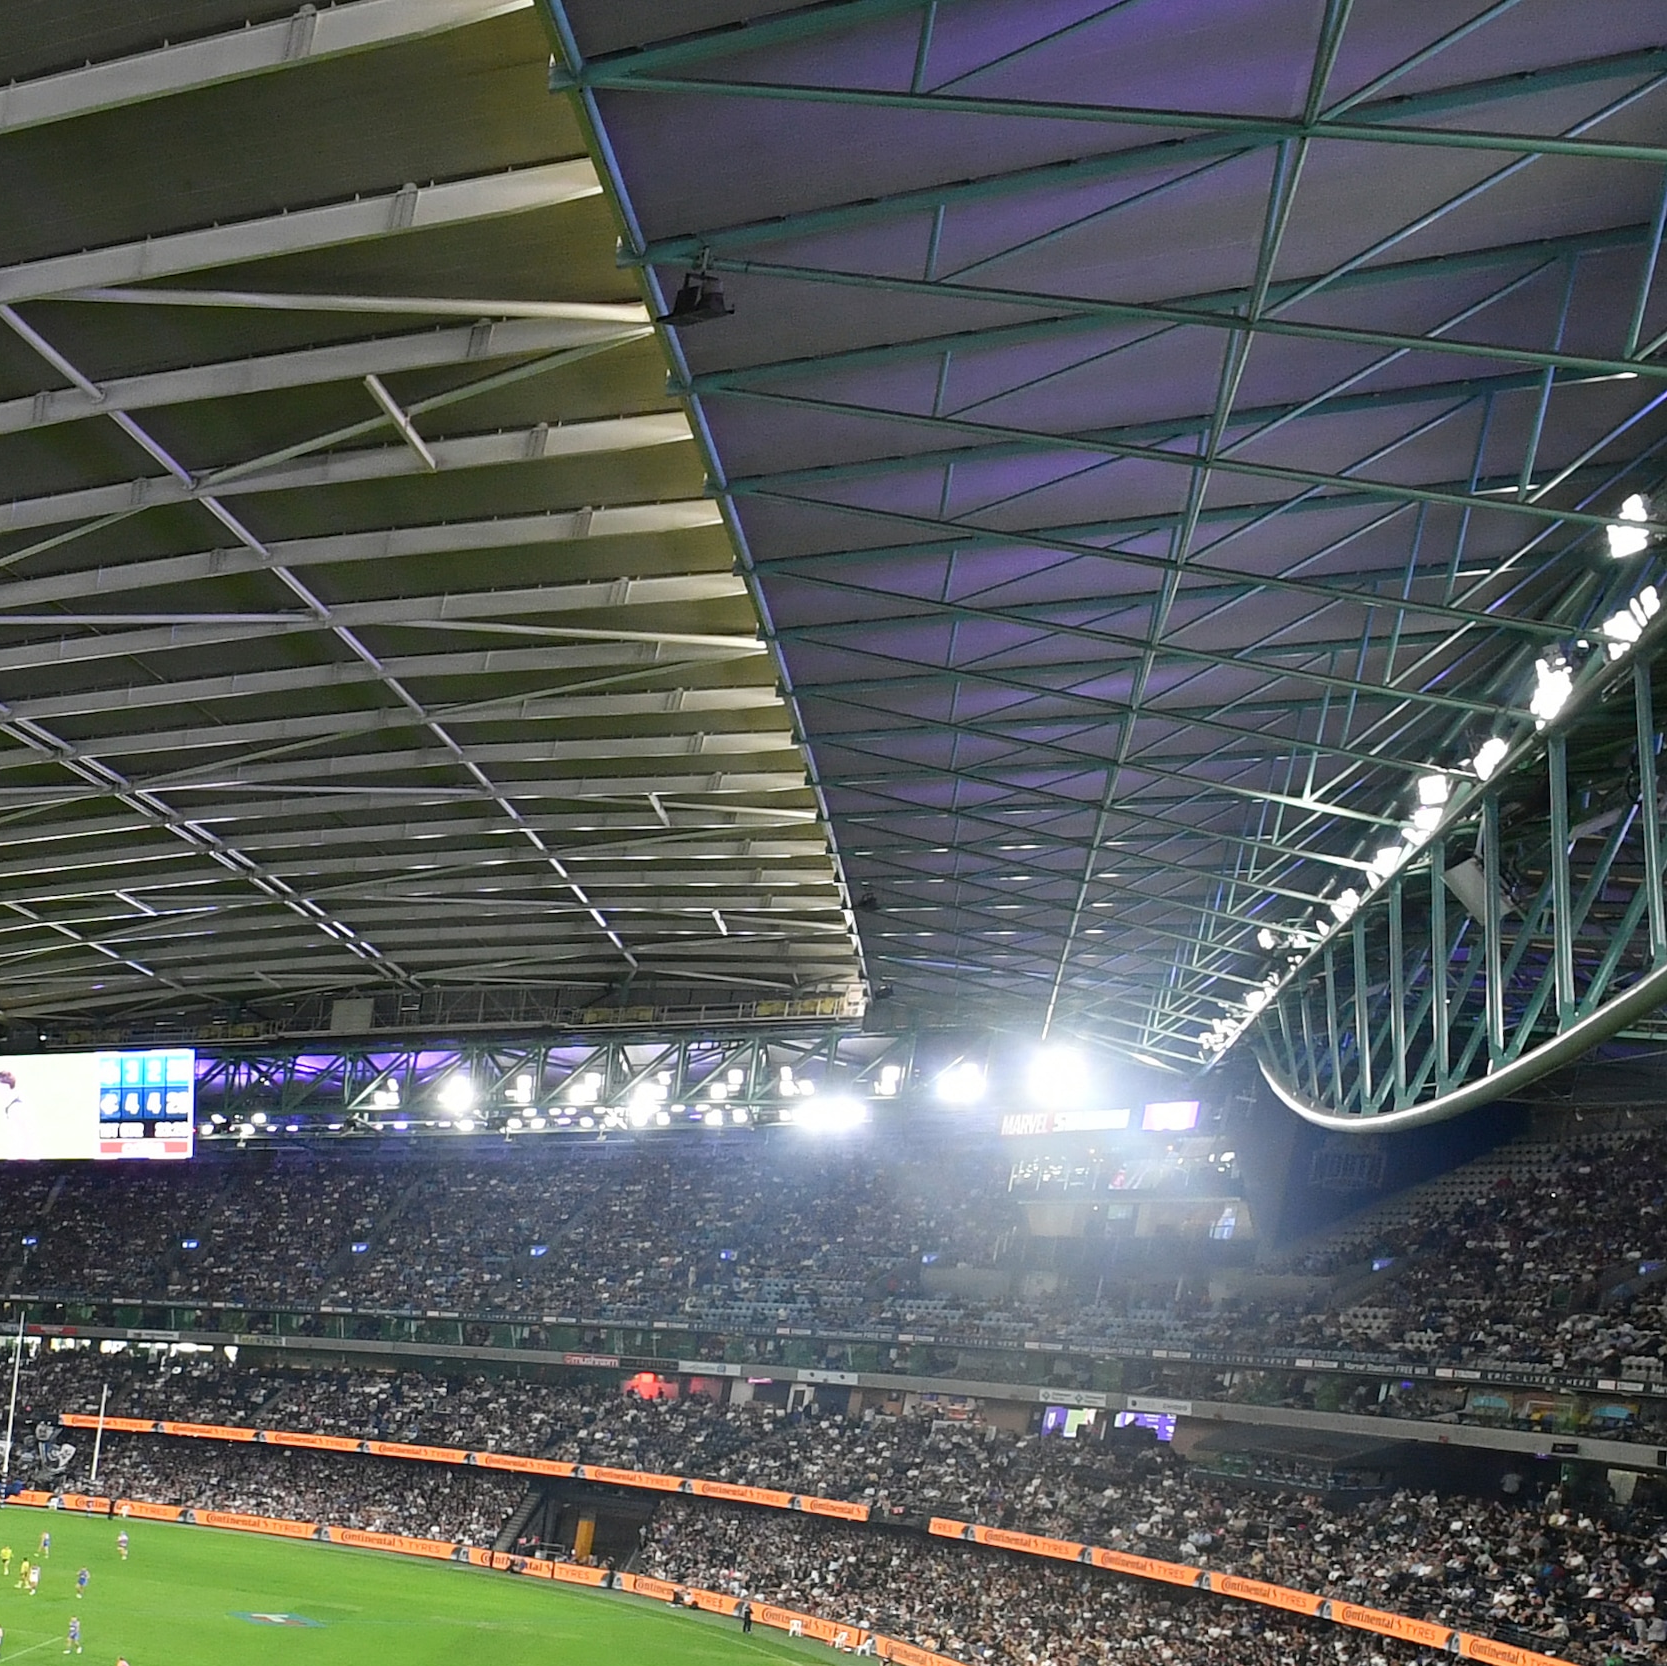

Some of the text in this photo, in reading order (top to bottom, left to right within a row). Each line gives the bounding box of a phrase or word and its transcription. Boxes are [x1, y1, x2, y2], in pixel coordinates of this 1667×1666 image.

[1000, 1112, 1049, 1136] MARVEL
[378, 1442, 421, 1457] Continental
[485, 1455, 528, 1470] Continental
[595, 1468, 636, 1483] Continental
[701, 1483, 748, 1498] Continental
[809, 1500, 855, 1516] Continental
[206, 1512, 260, 1529] Continental
[340, 1530, 441, 1555] Continental TYRES
[984, 1529, 1070, 1555] Continental TYRES
[1100, 1553, 1186, 1580] Continental TYRES
[1221, 1577, 1308, 1609] Continental TYRES
[1341, 1605, 1437, 1642] Continental TYRES
[1468, 1638, 1520, 1666] Continental
